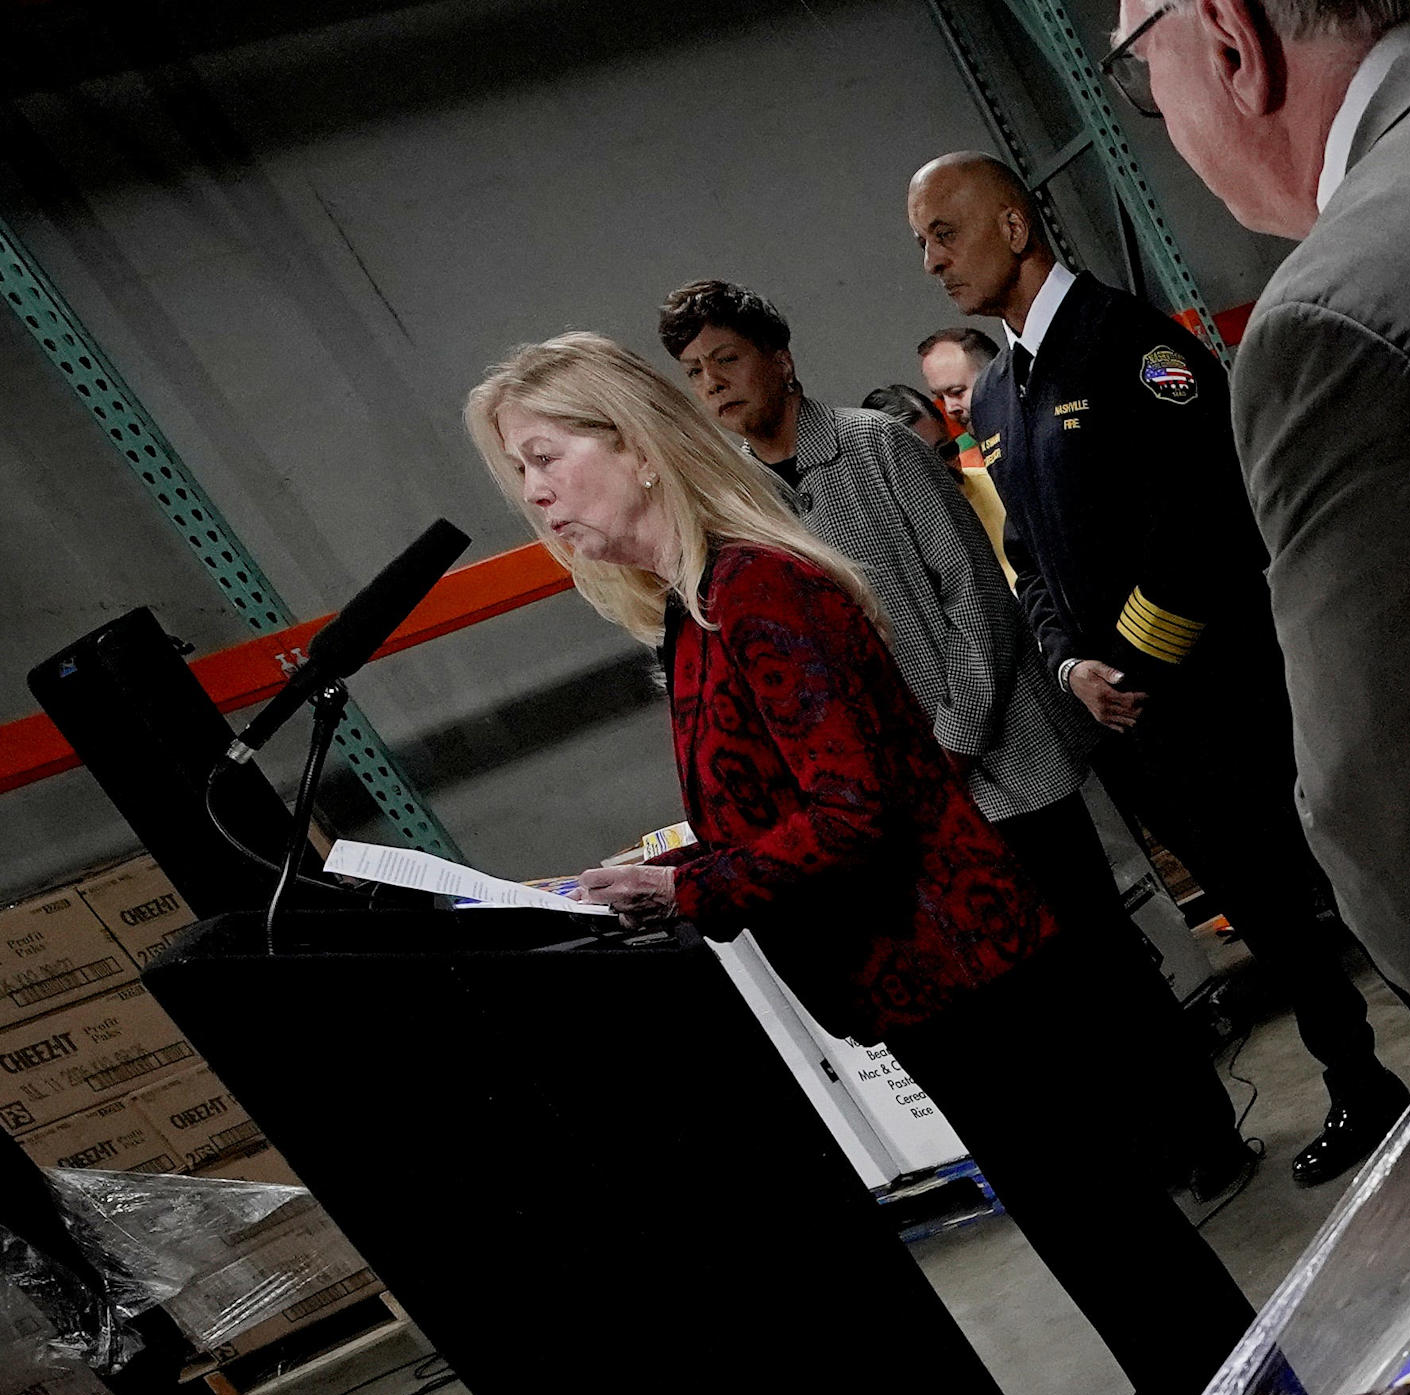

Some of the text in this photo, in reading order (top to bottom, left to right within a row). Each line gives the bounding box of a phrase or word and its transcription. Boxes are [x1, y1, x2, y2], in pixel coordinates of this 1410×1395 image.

[1054, 399, 1089, 416] NASHVILLE
[1064, 418, 1081, 430] FIRE
[858, 1069, 881, 1082] Mac
[880, 1063, 892, 1075] &
[910, 1106, 934, 1119] Rice
